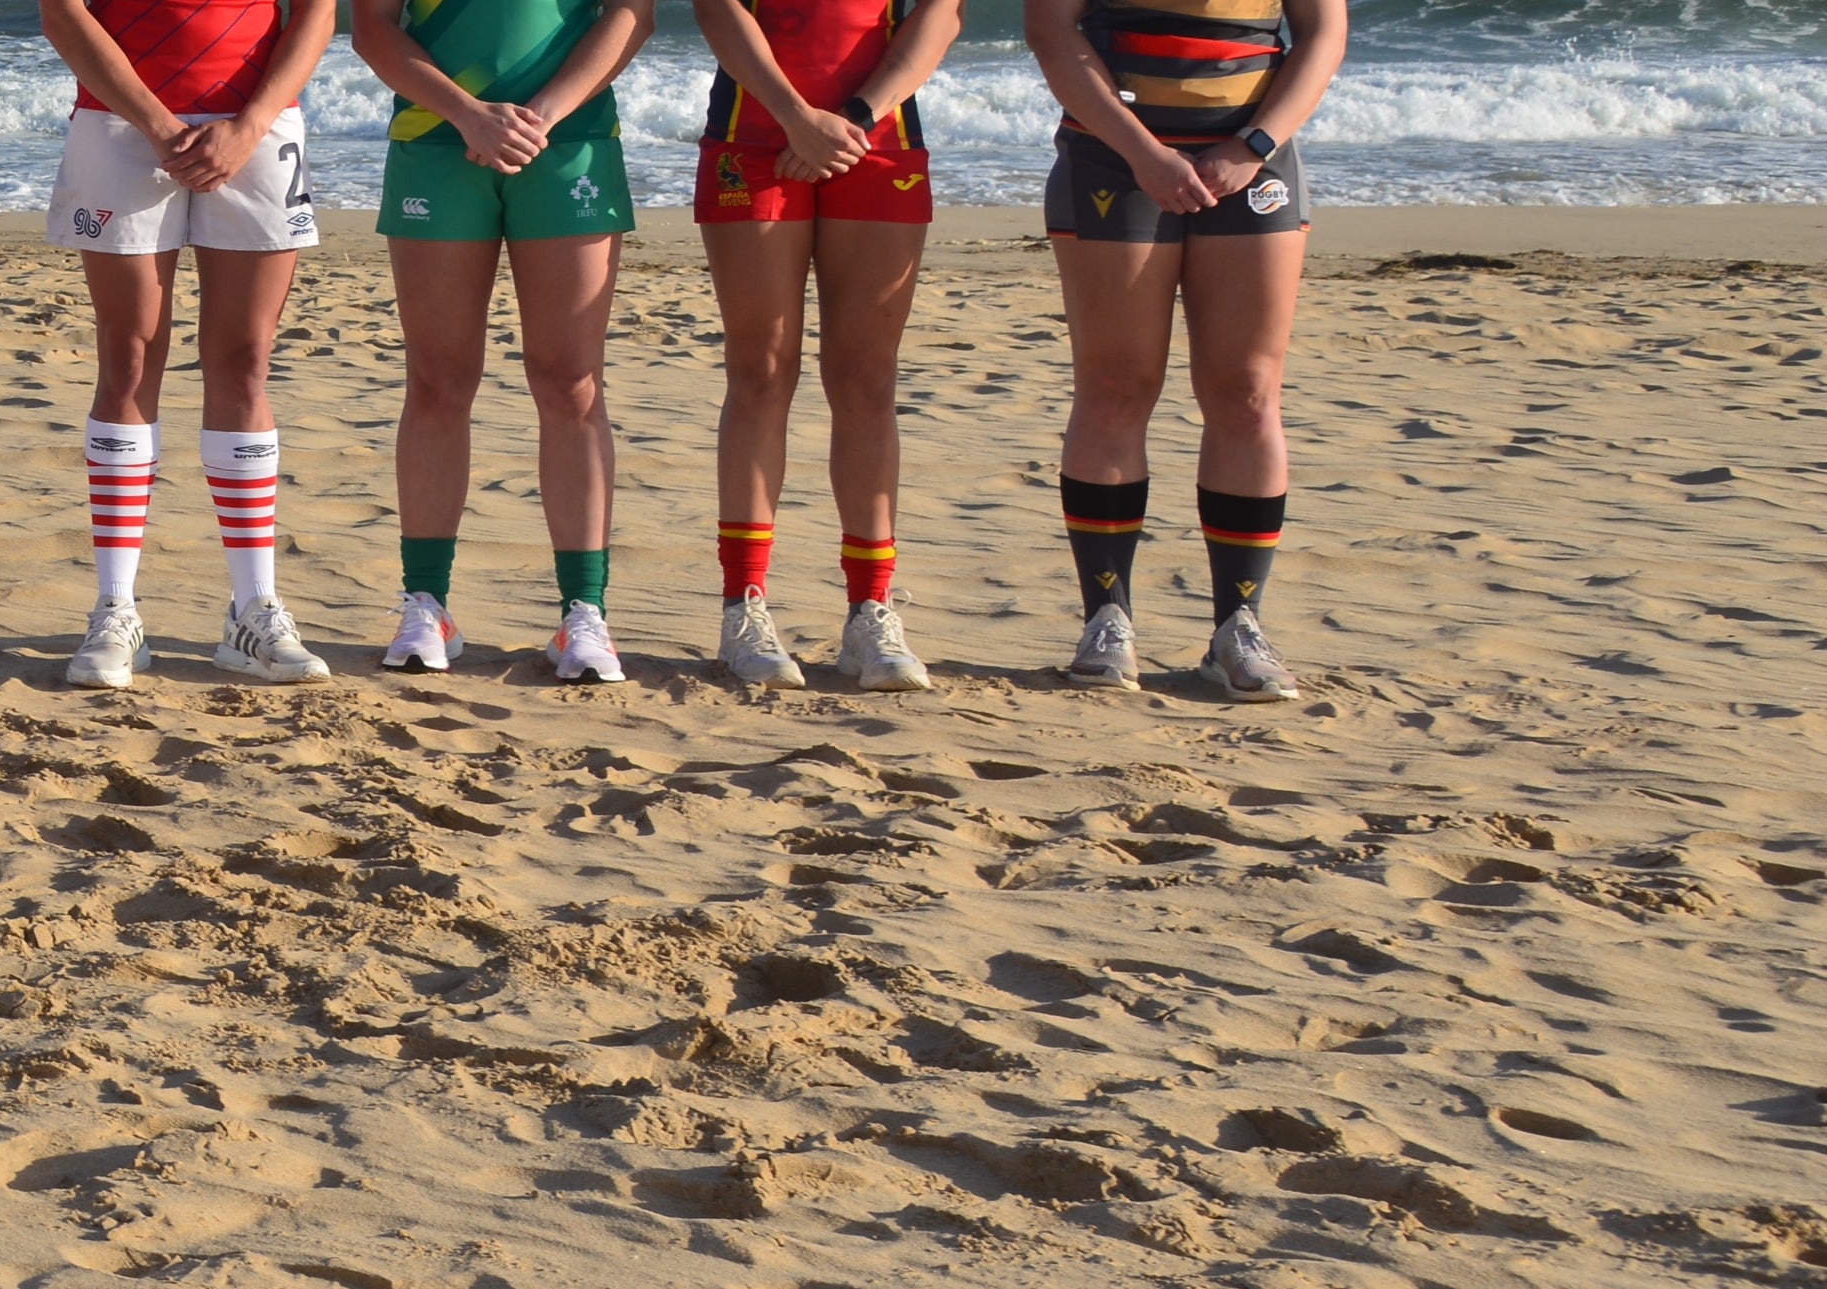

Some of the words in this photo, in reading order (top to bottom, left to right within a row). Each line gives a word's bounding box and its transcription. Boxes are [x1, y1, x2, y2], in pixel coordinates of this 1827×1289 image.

[278, 142, 311, 209] 2
[576, 208, 597, 218] IRFU
[90, 443, 136, 452] umbro
